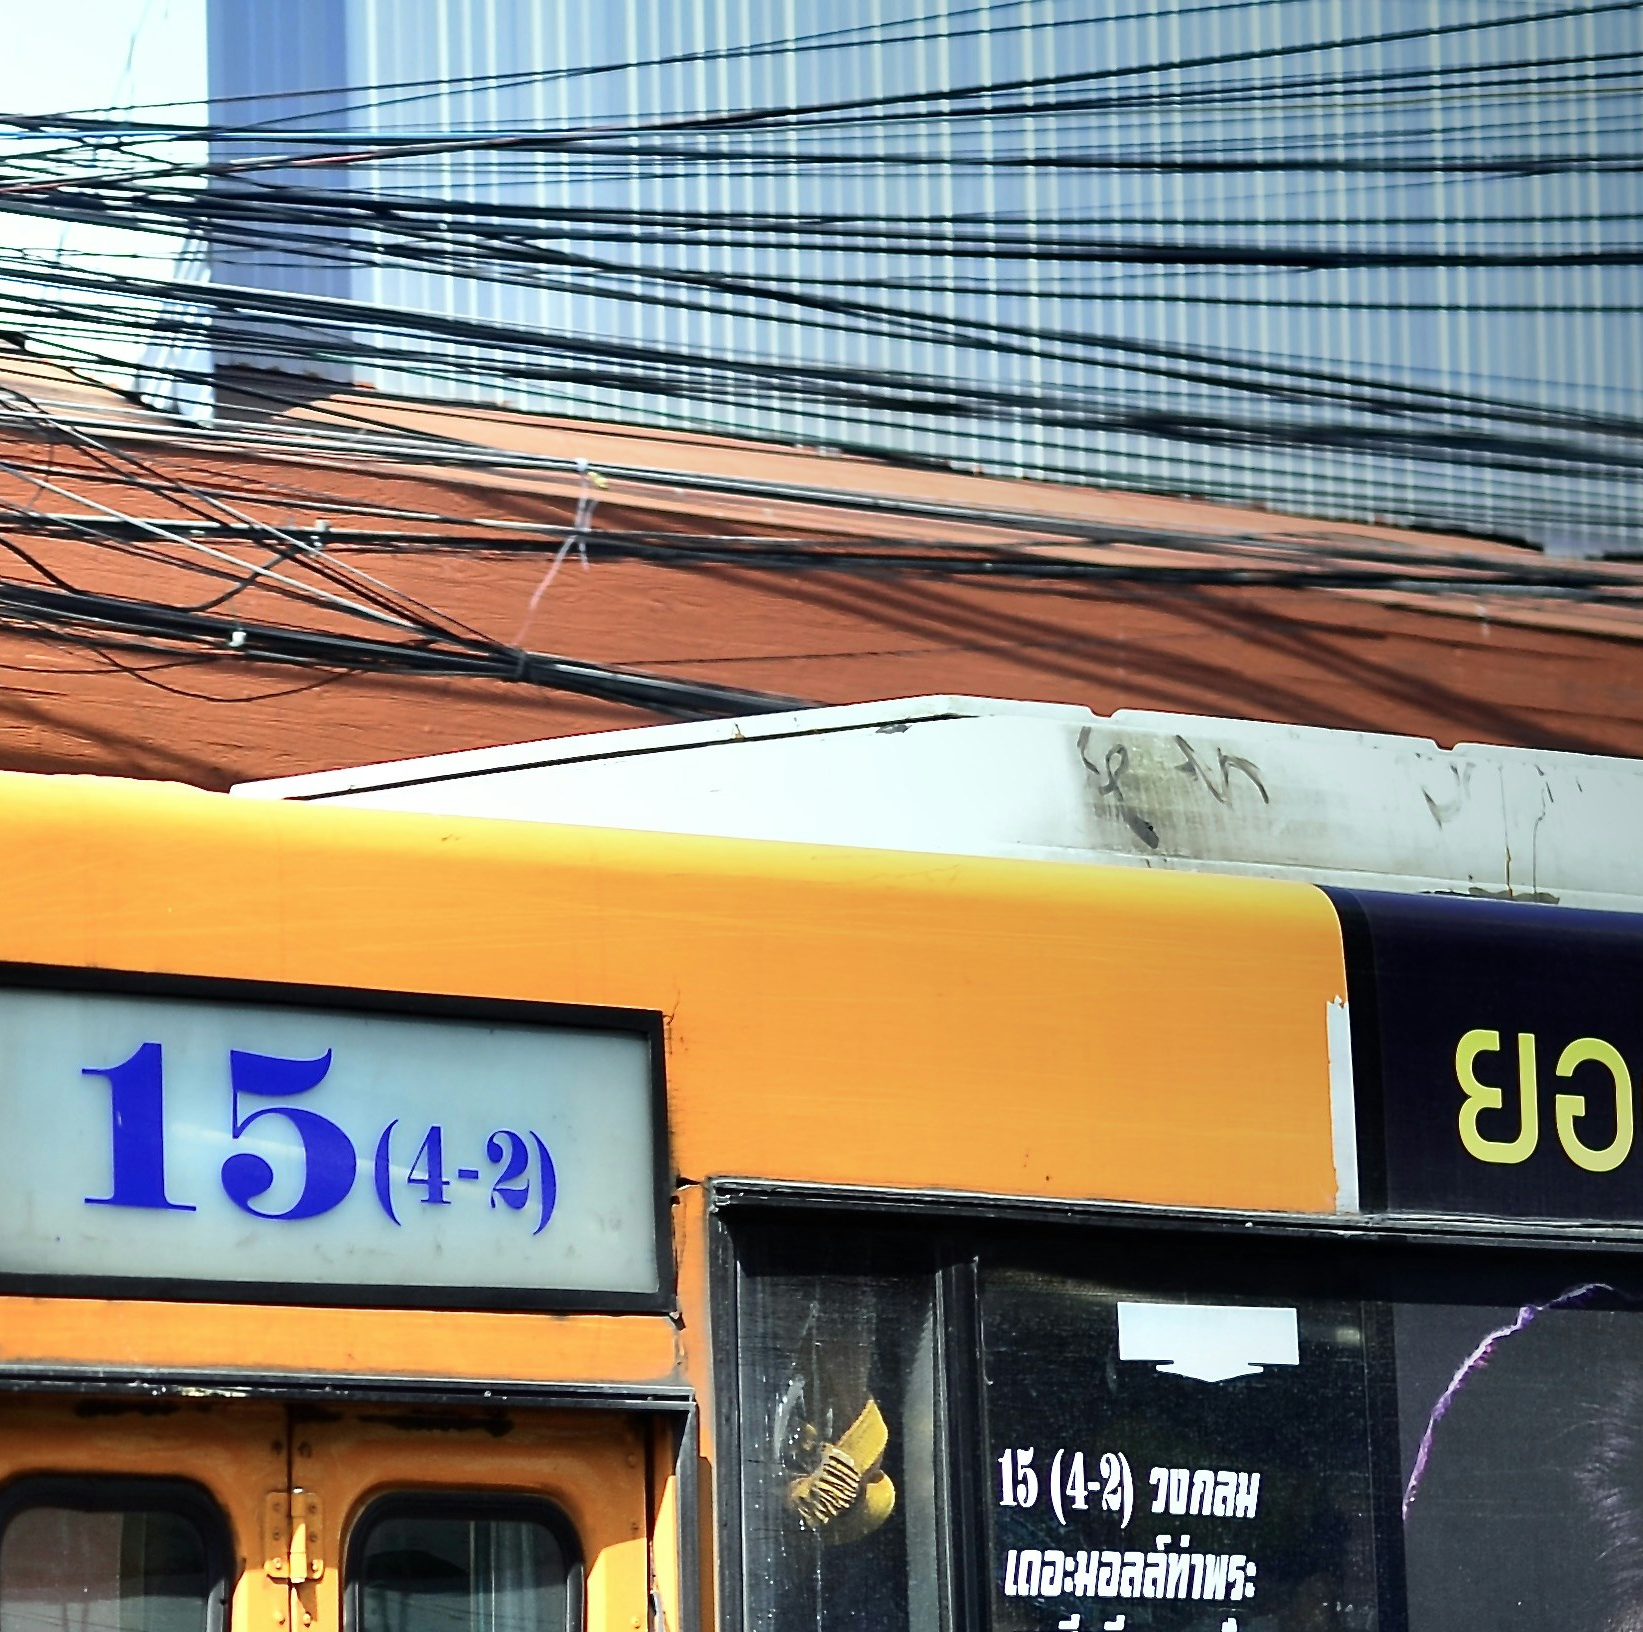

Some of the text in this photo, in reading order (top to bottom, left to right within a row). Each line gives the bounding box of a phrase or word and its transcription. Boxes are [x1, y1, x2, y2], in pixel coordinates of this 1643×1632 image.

[81, 1041, 557, 1236] 15 (4-2)
[998, 1447, 1261, 1529] 15 (4-2) วงกลม
